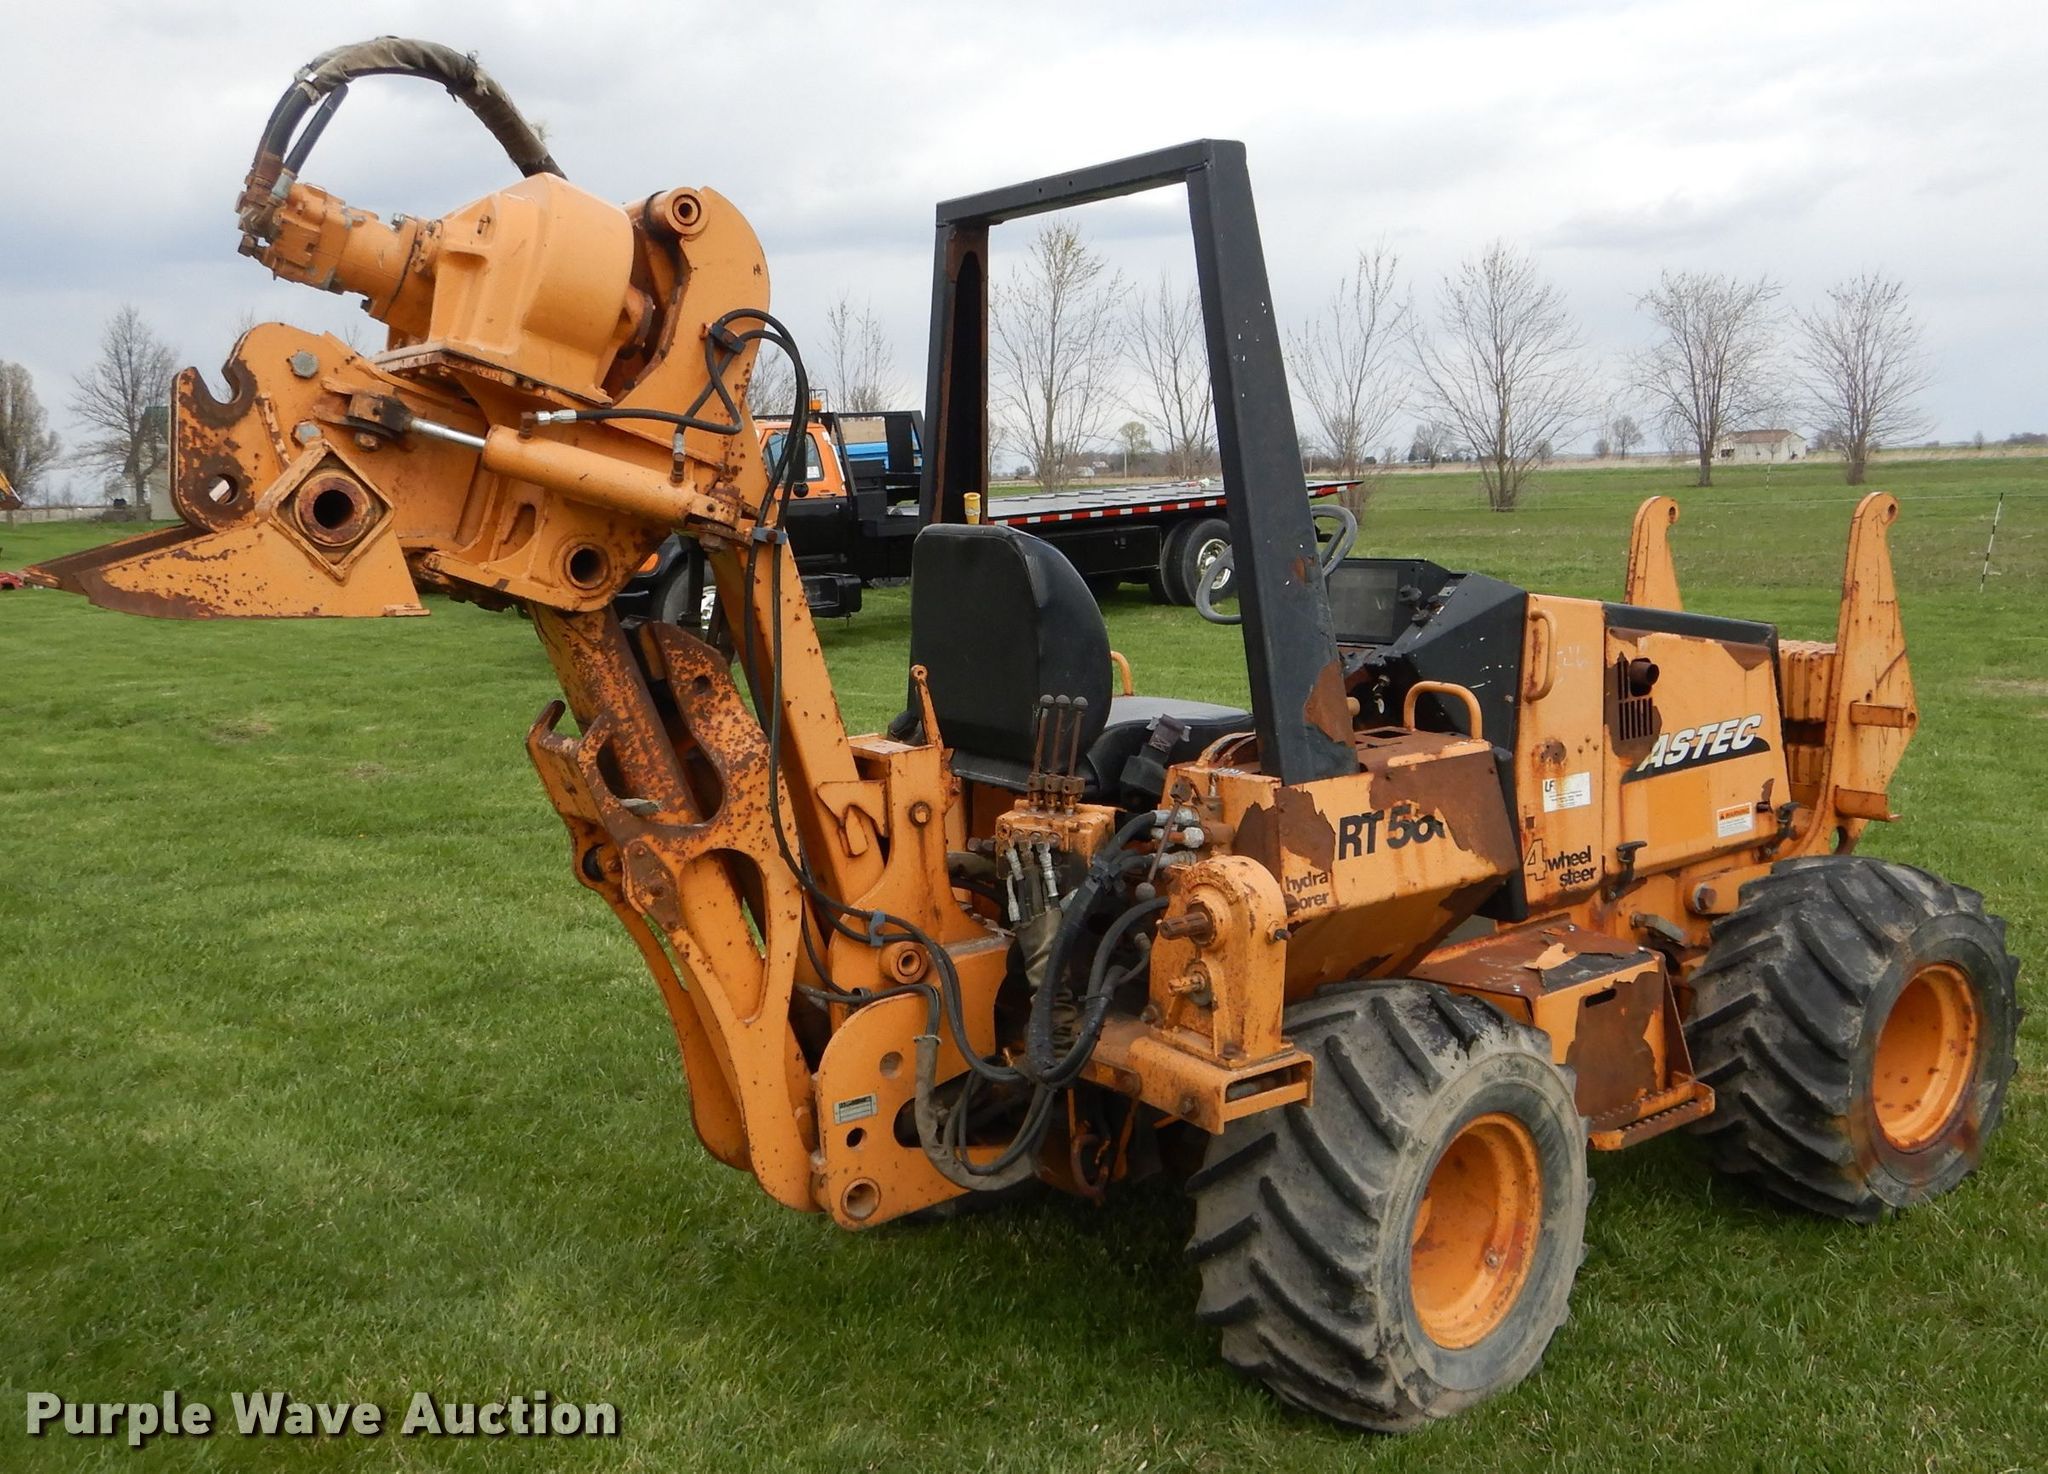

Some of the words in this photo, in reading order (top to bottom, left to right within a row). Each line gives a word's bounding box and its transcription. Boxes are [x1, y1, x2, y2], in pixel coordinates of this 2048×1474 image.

[1635, 714, 1762, 772] ASTEC
[1338, 810, 1384, 860] RT
[1524, 838, 1547, 881] 4
[1547, 845, 1591, 871] wheel
[1285, 871, 1328, 893] hydra
[1560, 867, 1597, 887] steer
[1292, 892, 1329, 909] orer
